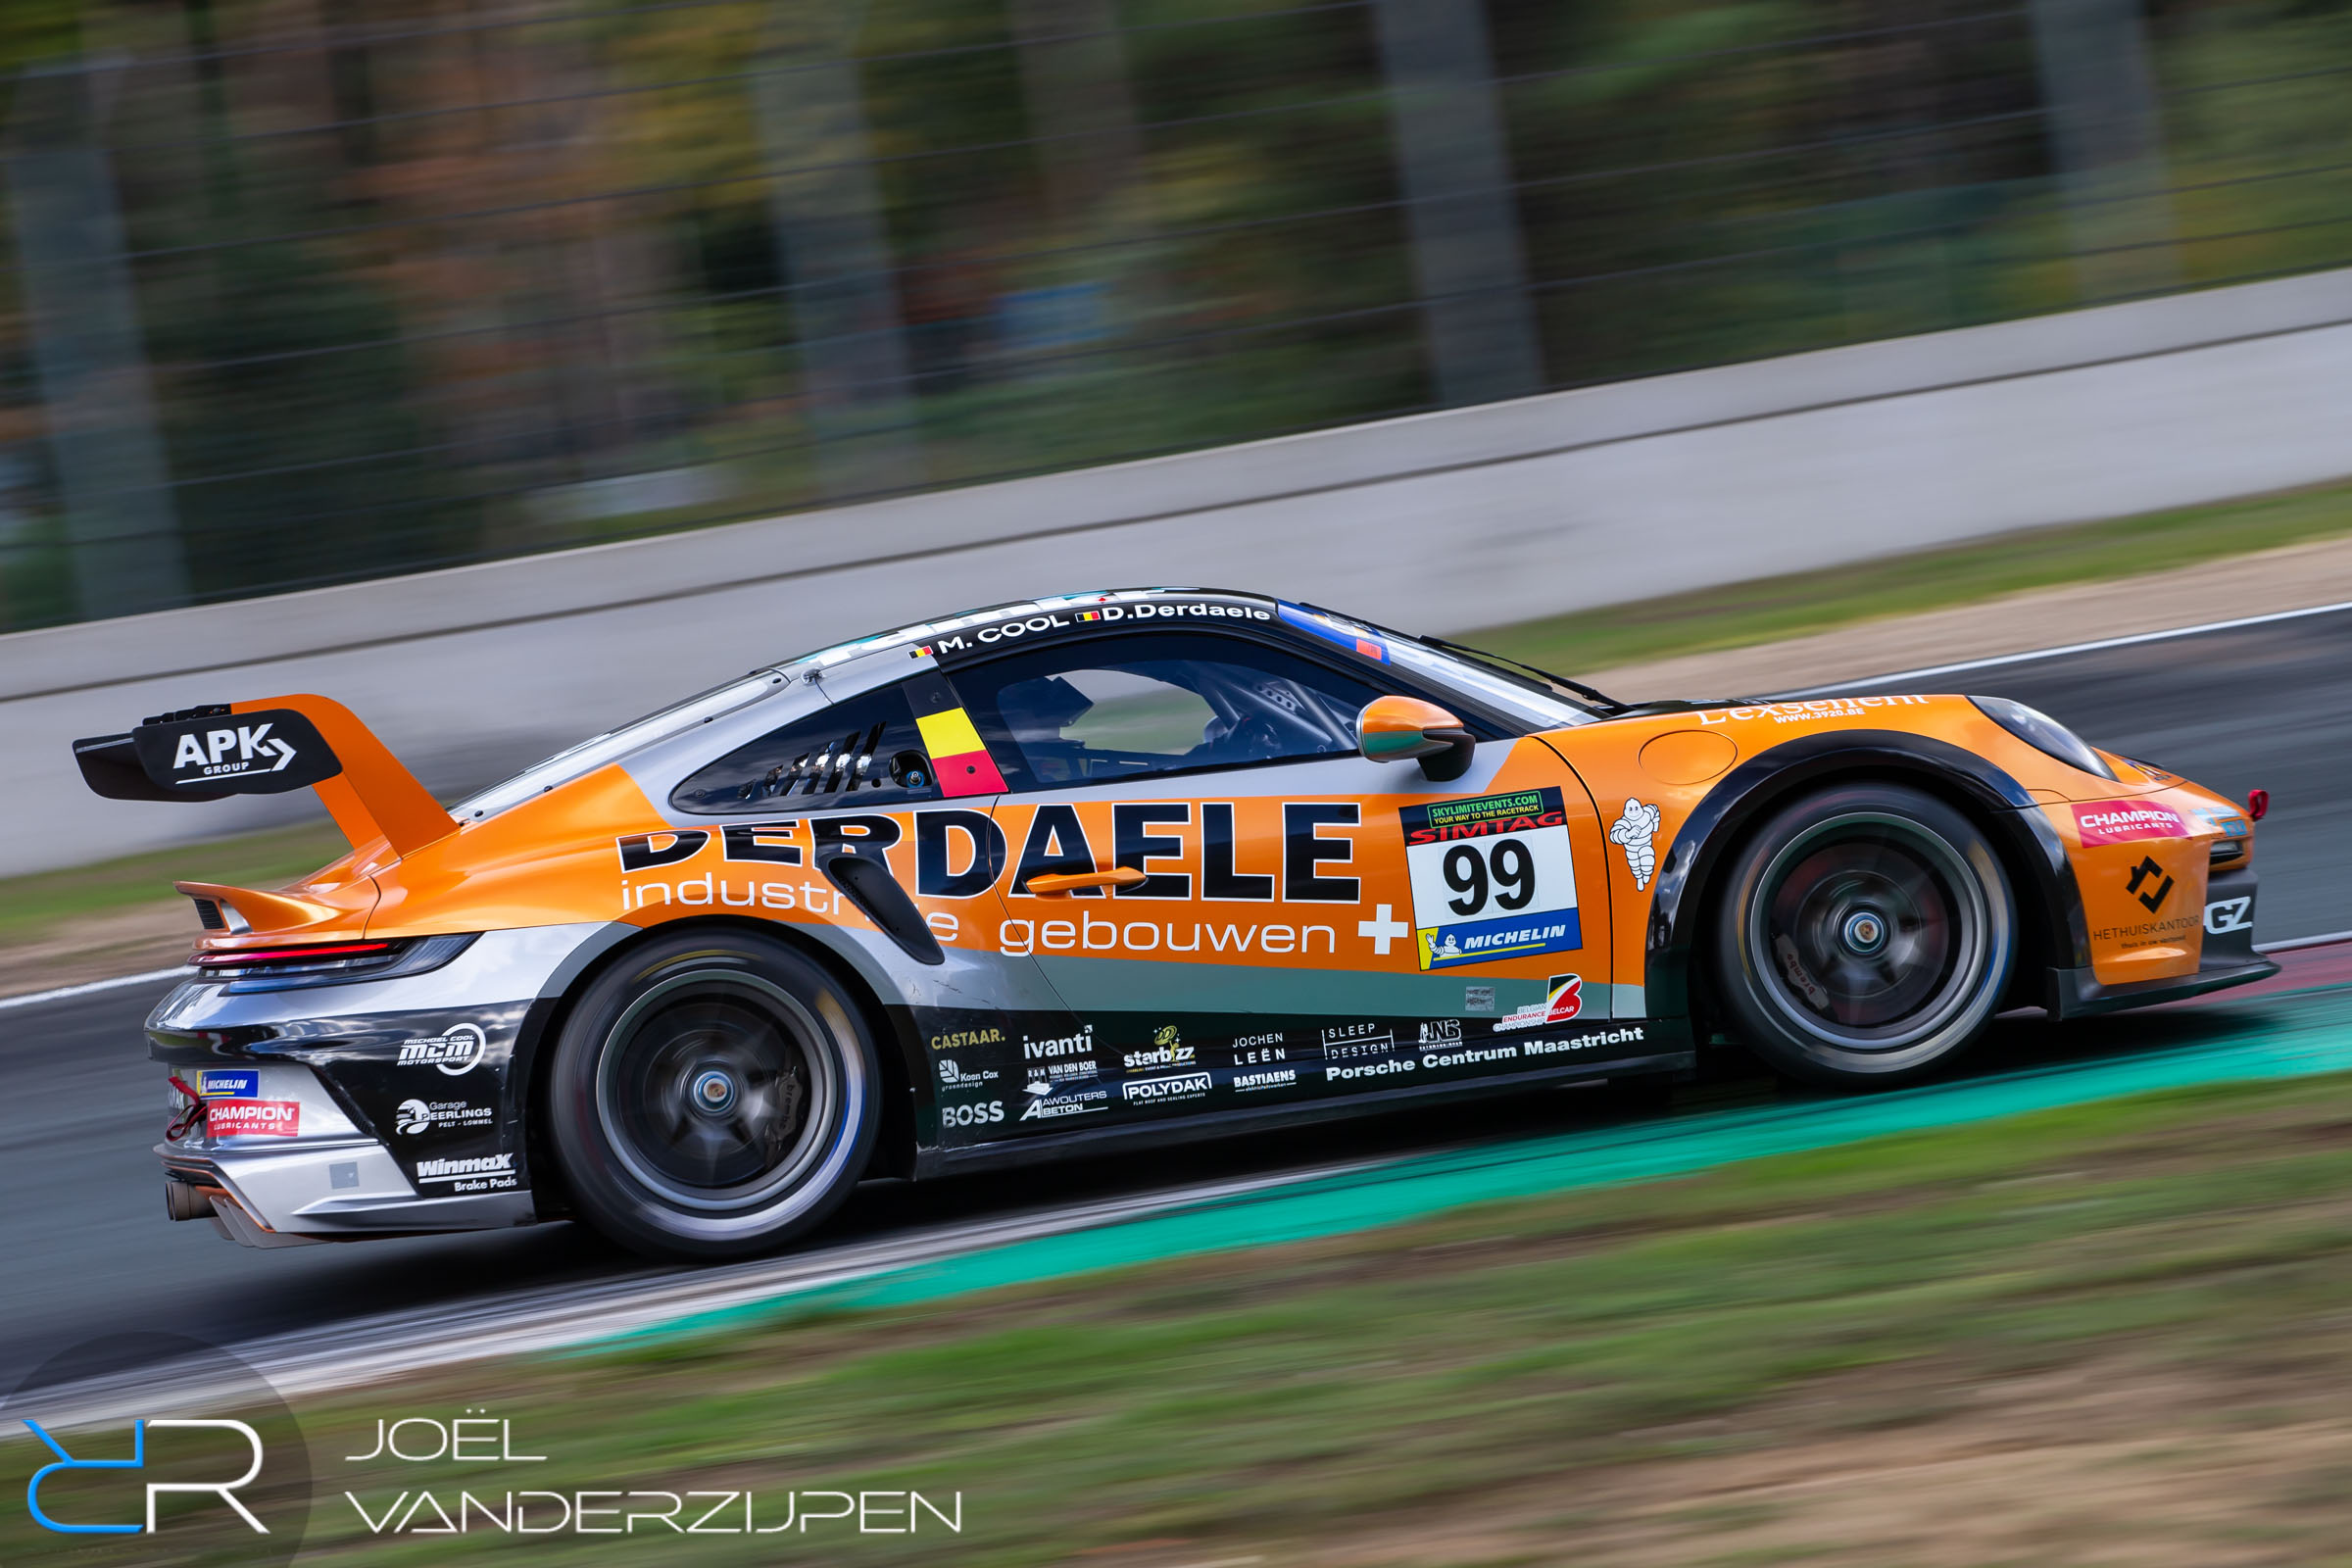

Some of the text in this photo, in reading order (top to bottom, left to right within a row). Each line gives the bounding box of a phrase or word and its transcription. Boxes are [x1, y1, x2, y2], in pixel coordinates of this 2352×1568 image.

[1102, 603, 1271, 621] D.Derdaele
[937, 636, 973, 655] M.
[977, 613, 1070, 643] COOL
[1773, 708, 1866, 723] WWW.3920.BE
[172, 722, 277, 769] APK
[203, 761, 249, 775] GROUP
[1432, 795, 1538, 818] SKYLIMITEVENTS.COM
[1434, 816, 1454, 825] YOUR
[1454, 813, 1470, 822] WAY
[1482, 809, 1496, 818] THE
[1496, 805, 1539, 816] RACETRACK
[2080, 810, 2180, 828] CHAMPION
[1408, 811, 1562, 845] SIMTAG
[2098, 822, 2173, 835] LUBRICANTS
[615, 802, 1361, 905] DERDAELE
[1443, 839, 1536, 916] 99
[999, 910, 1336, 956] gebouwen
[1464, 925, 1566, 950] MICHELIN
[1503, 1011, 1546, 1023] ENDURANCE
[1549, 1005, 1575, 1015] BELCAR
[1328, 1023, 1375, 1039] SLEEP
[1494, 1018, 1546, 1031] CHAMPIONSHIP
[404, 1036, 448, 1045] MICHAEL
[931, 1029, 1006, 1051] CASTAAR.
[1023, 1025, 1093, 1059] ivanti
[1232, 1032, 1283, 1049] JOCHEN
[1234, 1048, 1286, 1066] LEËN
[1326, 1058, 1416, 1081] Porsche
[1422, 1046, 1517, 1068] Centrum
[1523, 1027, 1643, 1055] Maastricht
[1331, 1043, 1389, 1059] DESIGN
[397, 1055, 470, 1066] MOTORSPORT
[1048, 1064, 1063, 1075] VAN
[1063, 1062, 1078, 1073] DEN
[1078, 1059, 1098, 1071] BOER
[207, 1079, 248, 1090] MICHELIN
[960, 1070, 1000, 1082] Koen Cox
[1233, 1069, 1297, 1088] BASTIAENS
[1127, 1078, 1208, 1100] POLYDAK
[429, 1100, 467, 1111] Garage
[1043, 1090, 1107, 1107] AWOUTERS
[209, 1105, 292, 1122] CHAMPION
[421, 1107, 493, 1121] PEERLINGS
[942, 1100, 1005, 1128] BOSS
[1043, 1102, 1084, 1115] BETON
[214, 1122, 275, 1131] LUBRICANTS
[454, 1176, 517, 1192] Brake Pads
